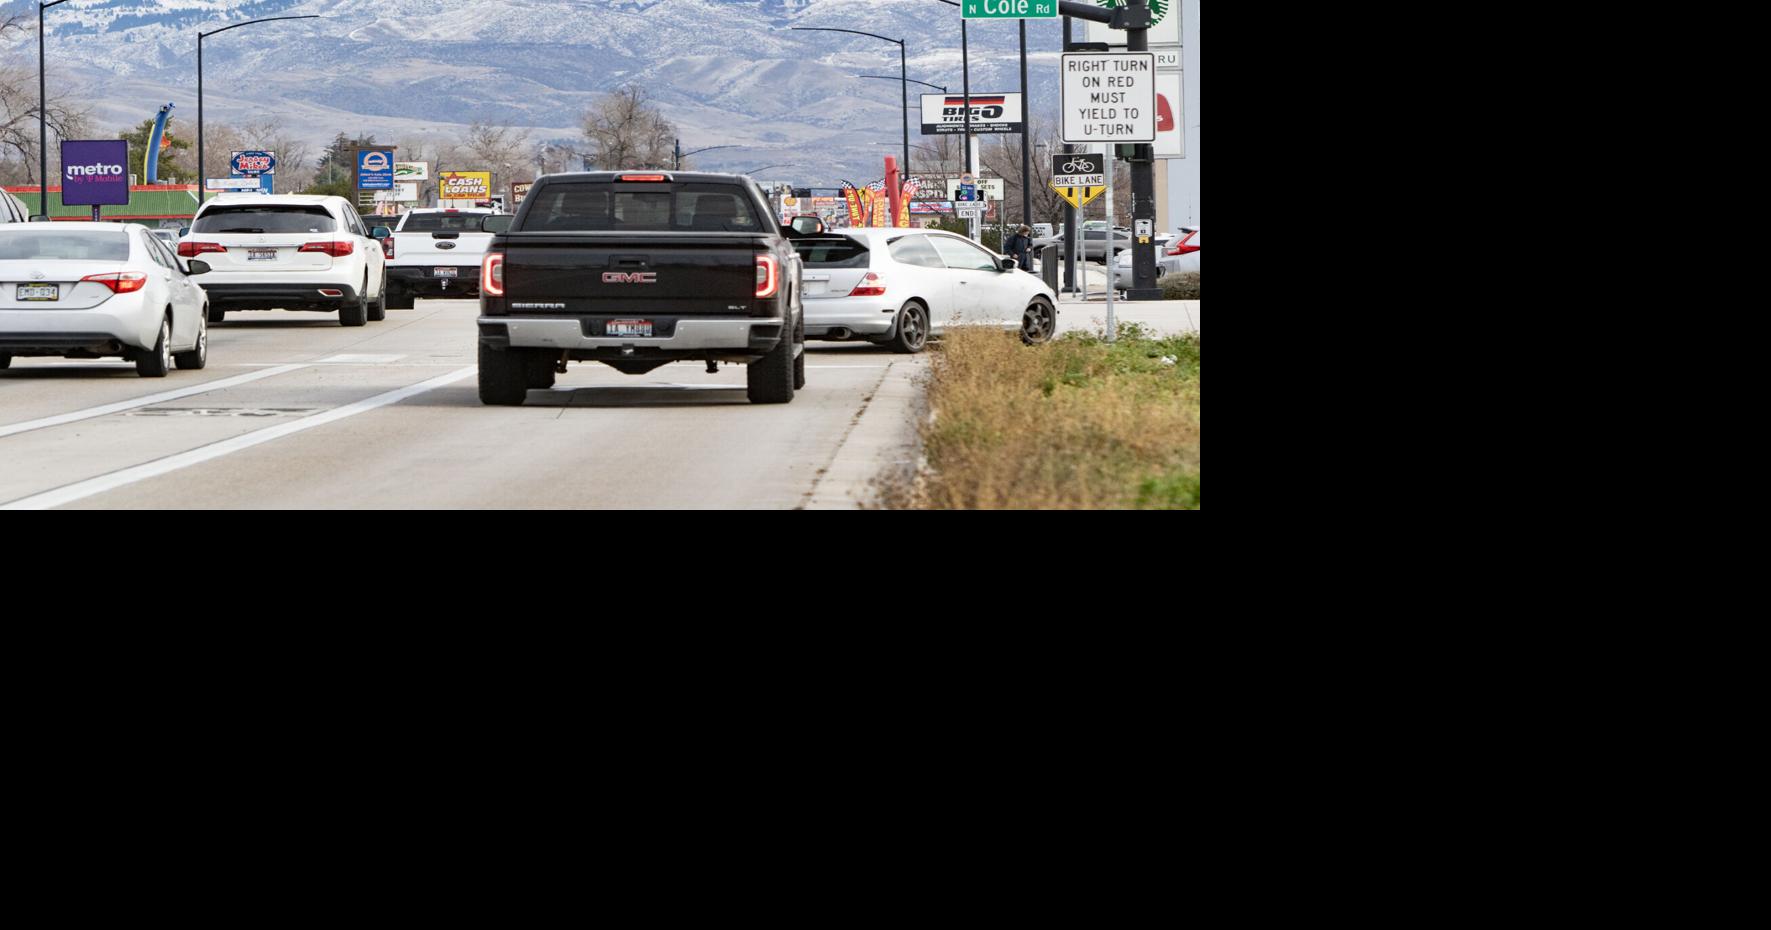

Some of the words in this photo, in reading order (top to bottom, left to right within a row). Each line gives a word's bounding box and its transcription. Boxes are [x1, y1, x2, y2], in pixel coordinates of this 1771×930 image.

[969, 5, 976, 14] N
[984, 0, 1028, 14] Cole
[1036, 4, 1049, 14] Rd
[1069, 60, 1106, 71] RIGHT
[1115, 60, 1148, 71] TURN
[1082, 77, 1100, 88] ON
[1108, 77, 1134, 87] RED
[1091, 92, 1125, 103] MUST
[1079, 108, 1116, 119] YIELD
[1124, 108, 1139, 119] TO
[1084, 124, 1133, 135] U-TURN
[67, 162, 123, 175] metro
[74, 175, 84, 184] by
[448, 178, 482, 186] CASH
[1055, 176, 1076, 185] BIKE
[1079, 175, 1102, 184] LANE
[445, 185, 487, 193] LOANS
[602, 272, 657, 283] GMC
